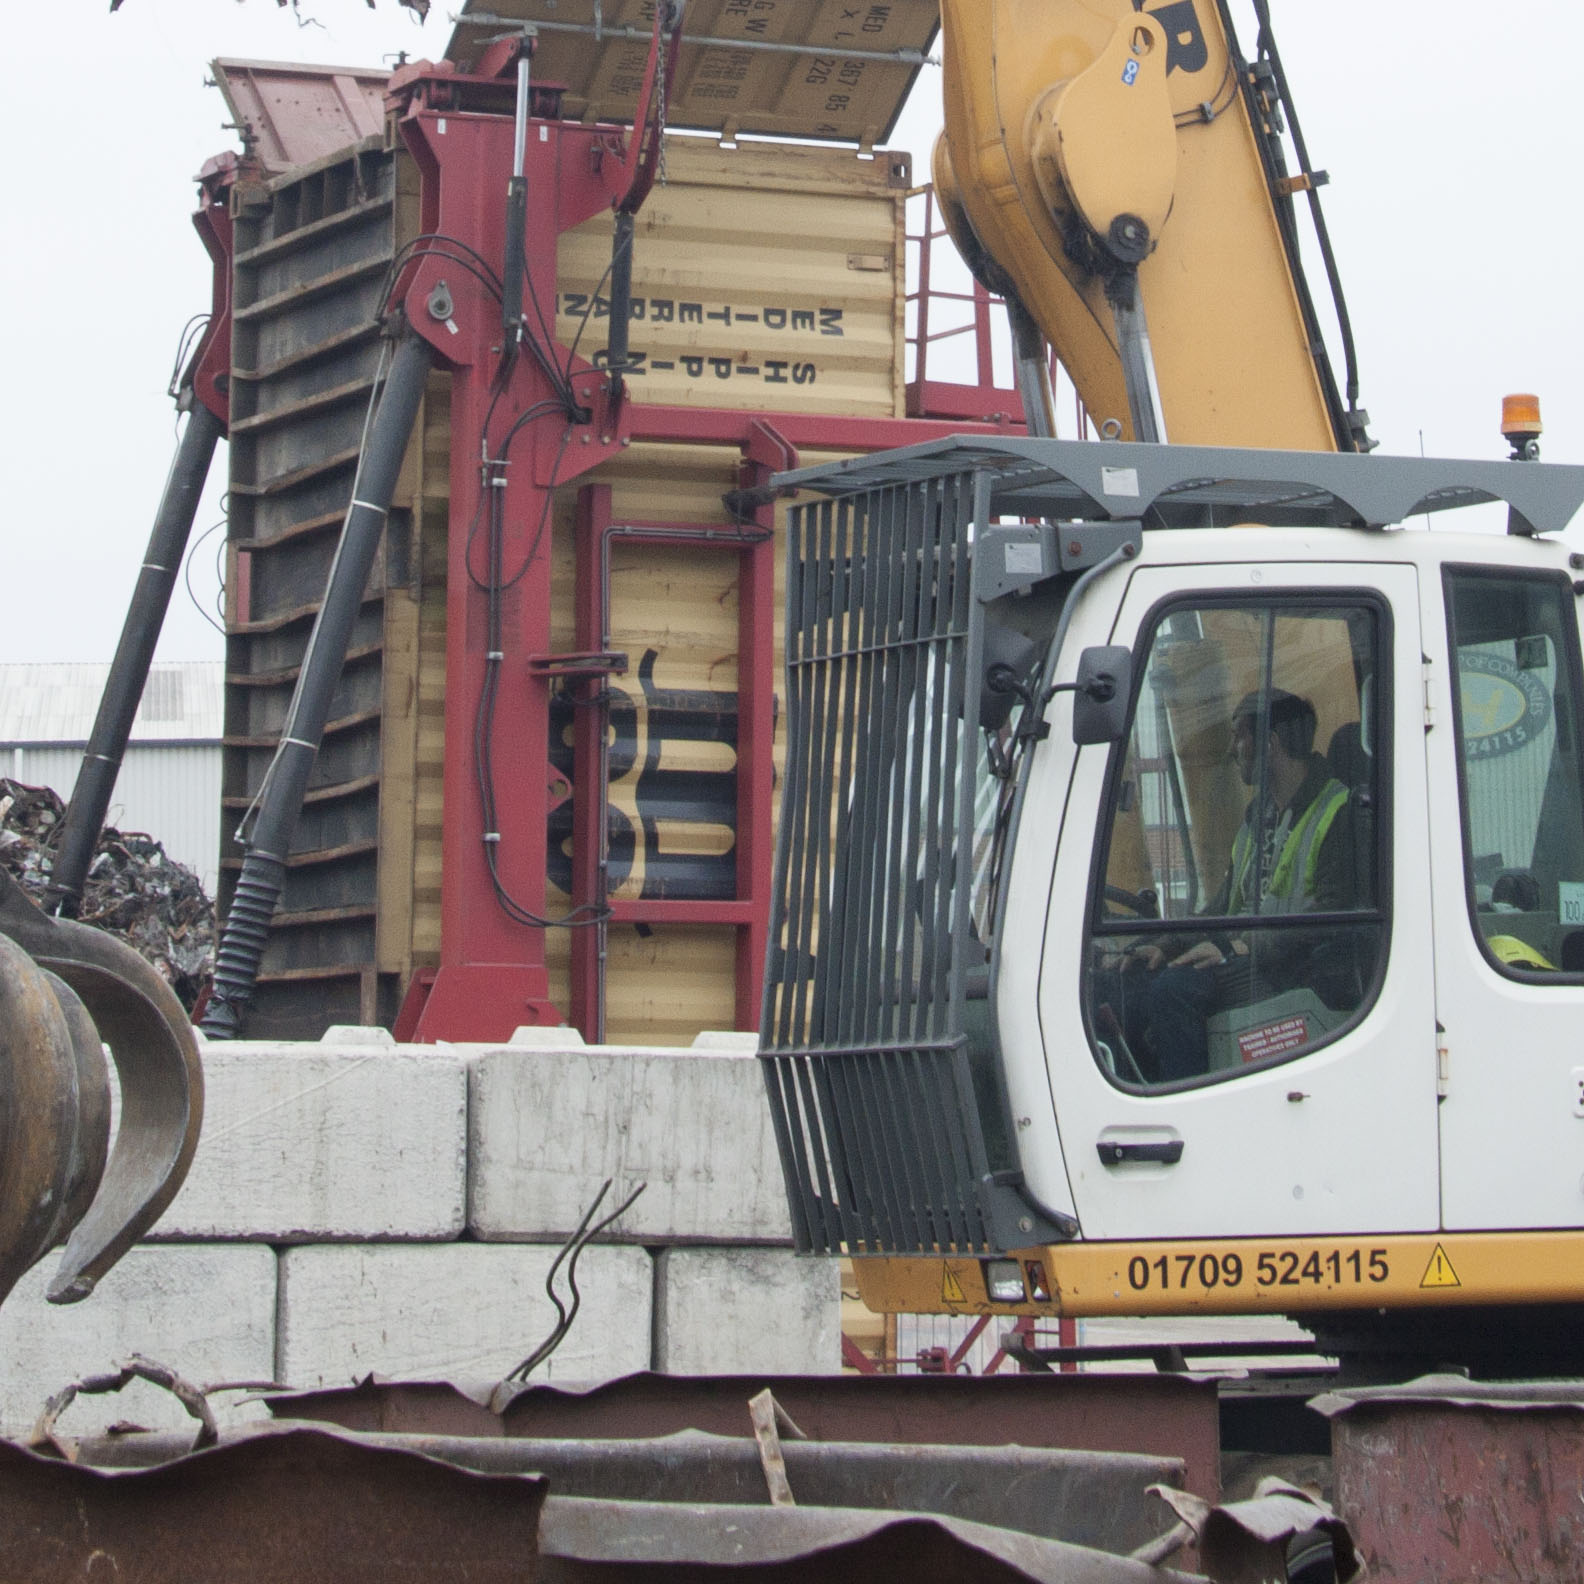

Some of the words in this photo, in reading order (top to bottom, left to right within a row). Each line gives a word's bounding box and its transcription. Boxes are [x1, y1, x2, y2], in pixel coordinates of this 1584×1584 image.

[556, 293, 844, 336] MEDITERRAN
[1466, 726, 1526, 754] 24115
[1127, 1253, 1244, 1291] 01709
[1255, 1248, 1390, 1287] 524115
